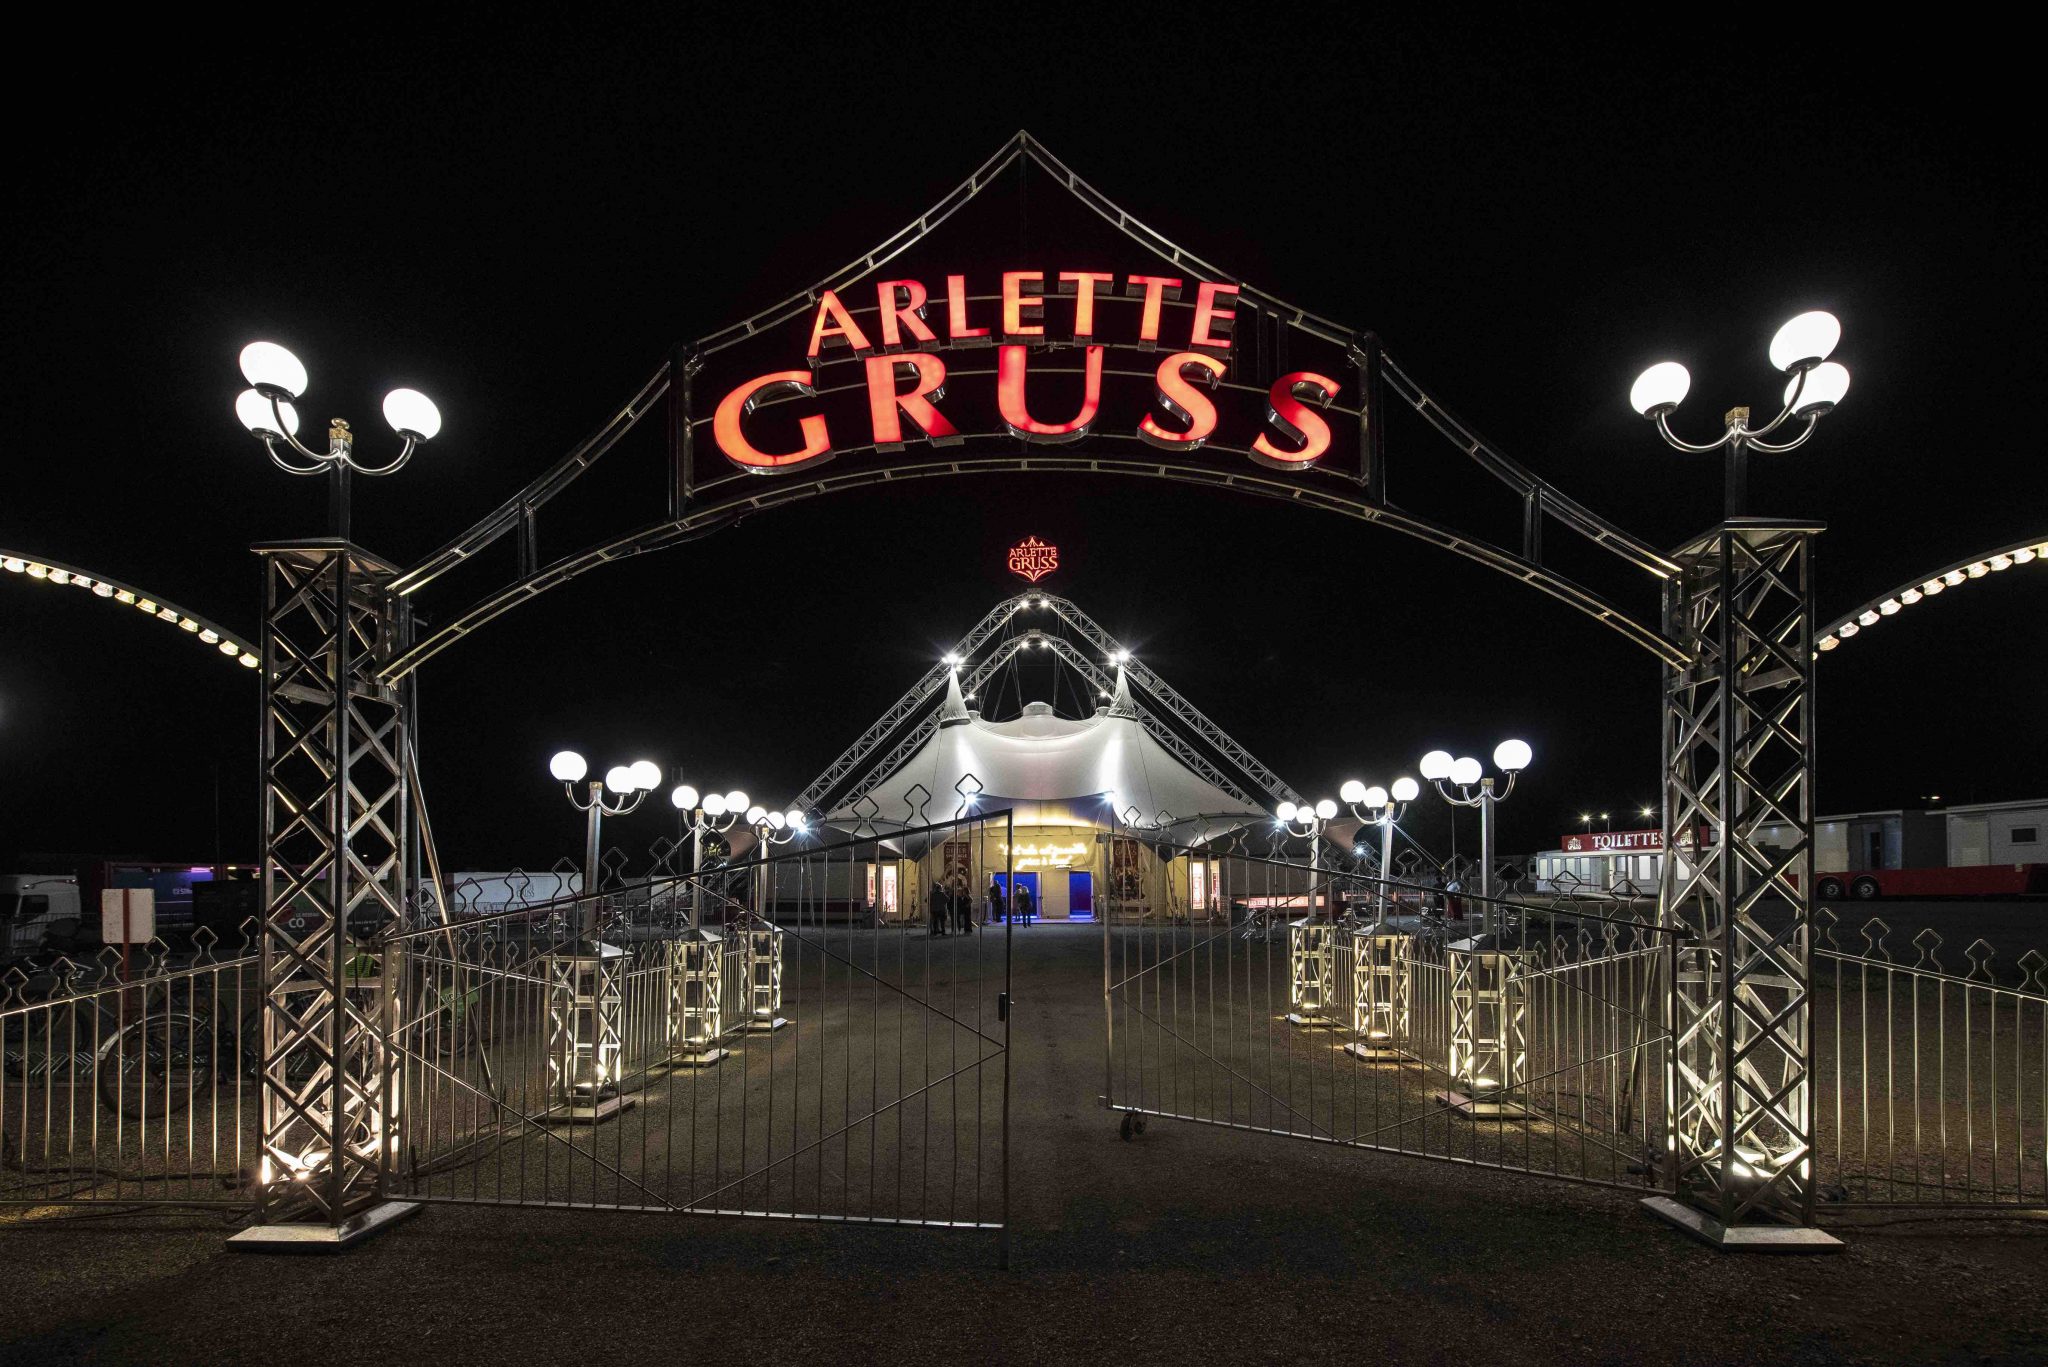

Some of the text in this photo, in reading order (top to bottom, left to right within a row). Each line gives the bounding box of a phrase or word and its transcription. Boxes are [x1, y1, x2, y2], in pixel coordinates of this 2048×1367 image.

[807, 271, 1240, 360] ARLETTE
[713, 345, 1342, 472] GRUSS
[1009, 546, 1057, 558] ARLETTE
[1009, 556, 1058, 571] GRUSS
